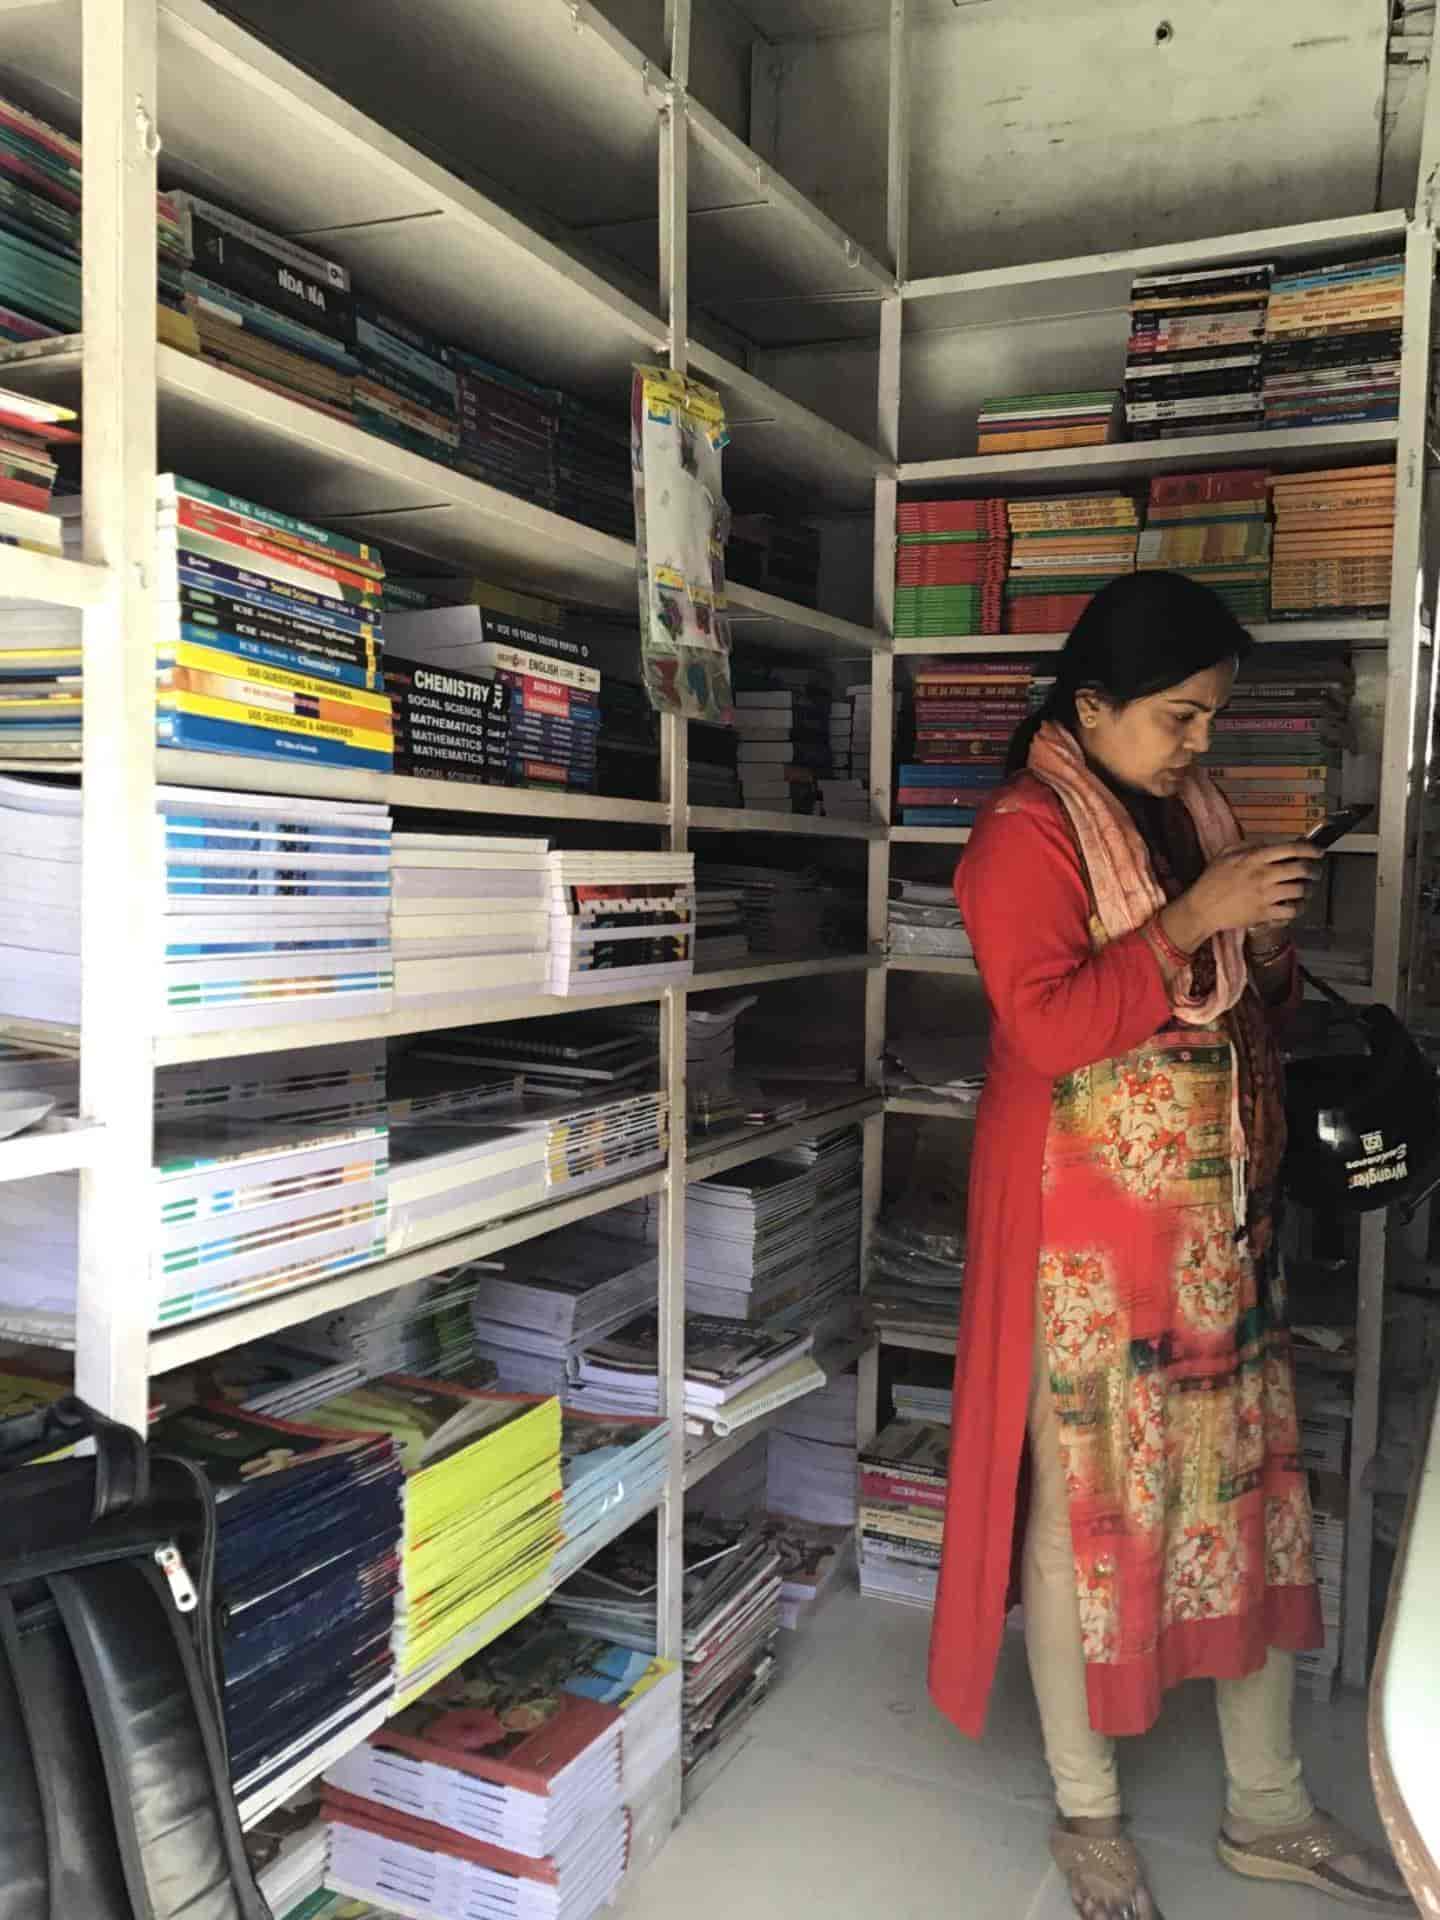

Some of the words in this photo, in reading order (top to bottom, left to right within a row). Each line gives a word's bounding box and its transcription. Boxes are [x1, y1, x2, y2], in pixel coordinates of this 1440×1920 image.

[278, 269, 305, 299] NDA
[307, 285, 326, 311] NA
[528, 657, 559, 675] ENGLISH
[414, 669, 490, 703] CHEMISTRY
[408, 694, 442, 711] SOCIAL
[444, 701, 482, 719] SCIENCE
[409, 711, 482, 736] MATHEMATICS
[411, 728, 482, 751] MATHEMATICS
[412, 743, 485, 765] MATHEMATICS
[1348, 1161, 1408, 1189] Wrangler
